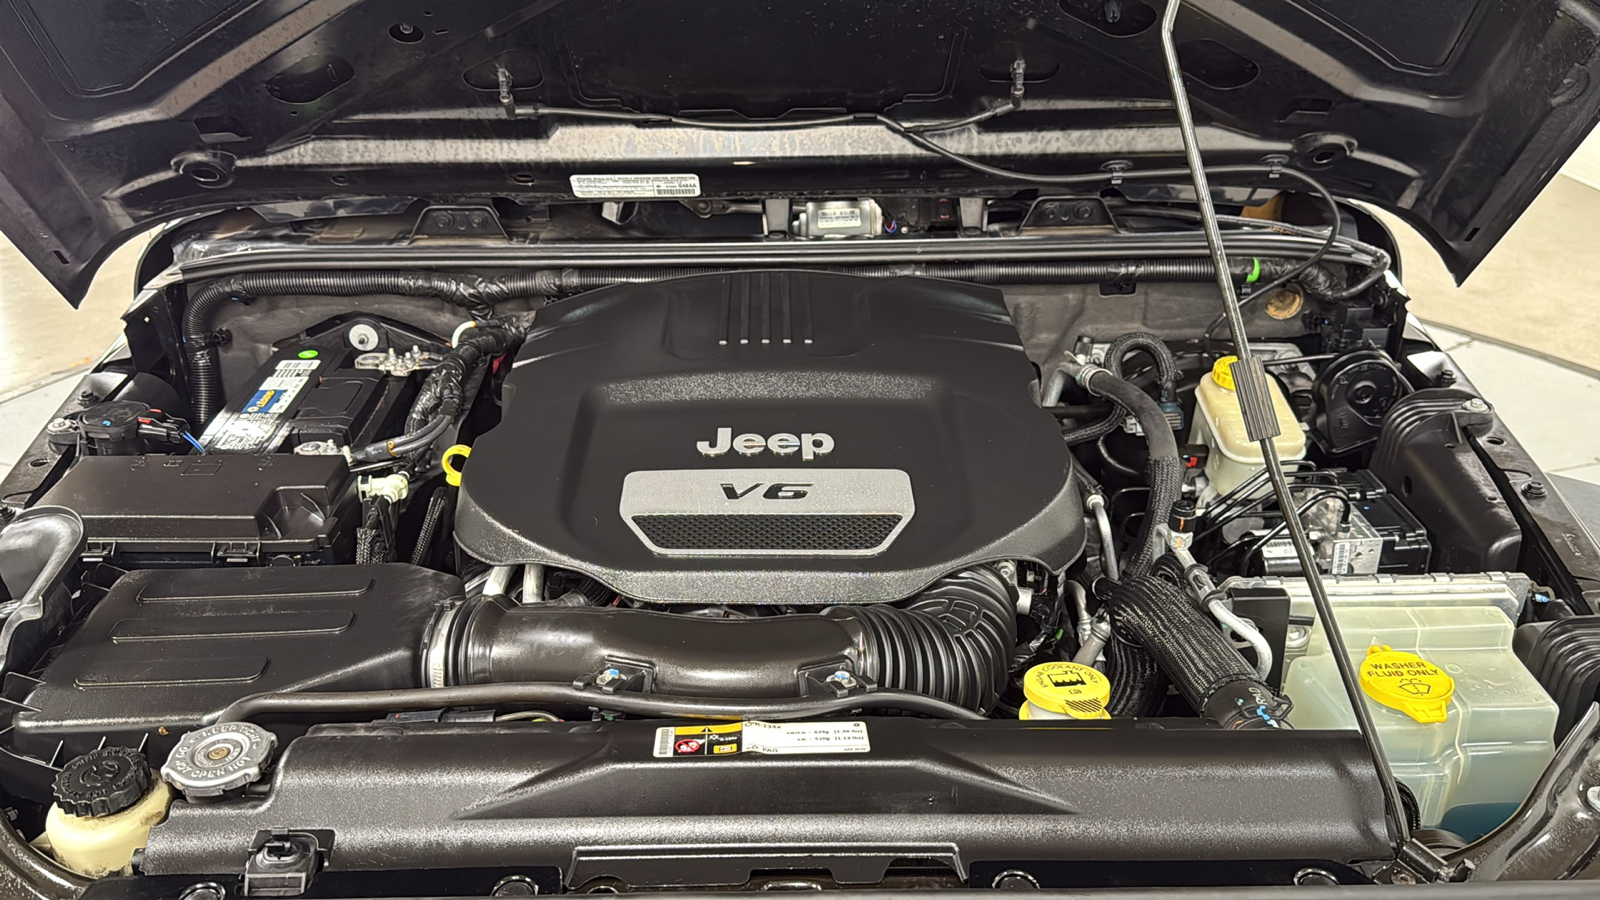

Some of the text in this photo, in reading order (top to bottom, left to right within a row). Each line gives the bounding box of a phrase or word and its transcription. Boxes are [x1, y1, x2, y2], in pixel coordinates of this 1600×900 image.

[696, 427, 835, 461] Jeep
[720, 482, 814, 500] V6
[1042, 664, 1083, 672] COOLANT
[1370, 661, 1427, 670] WASHER
[191, 769, 225, 778] OPEN
